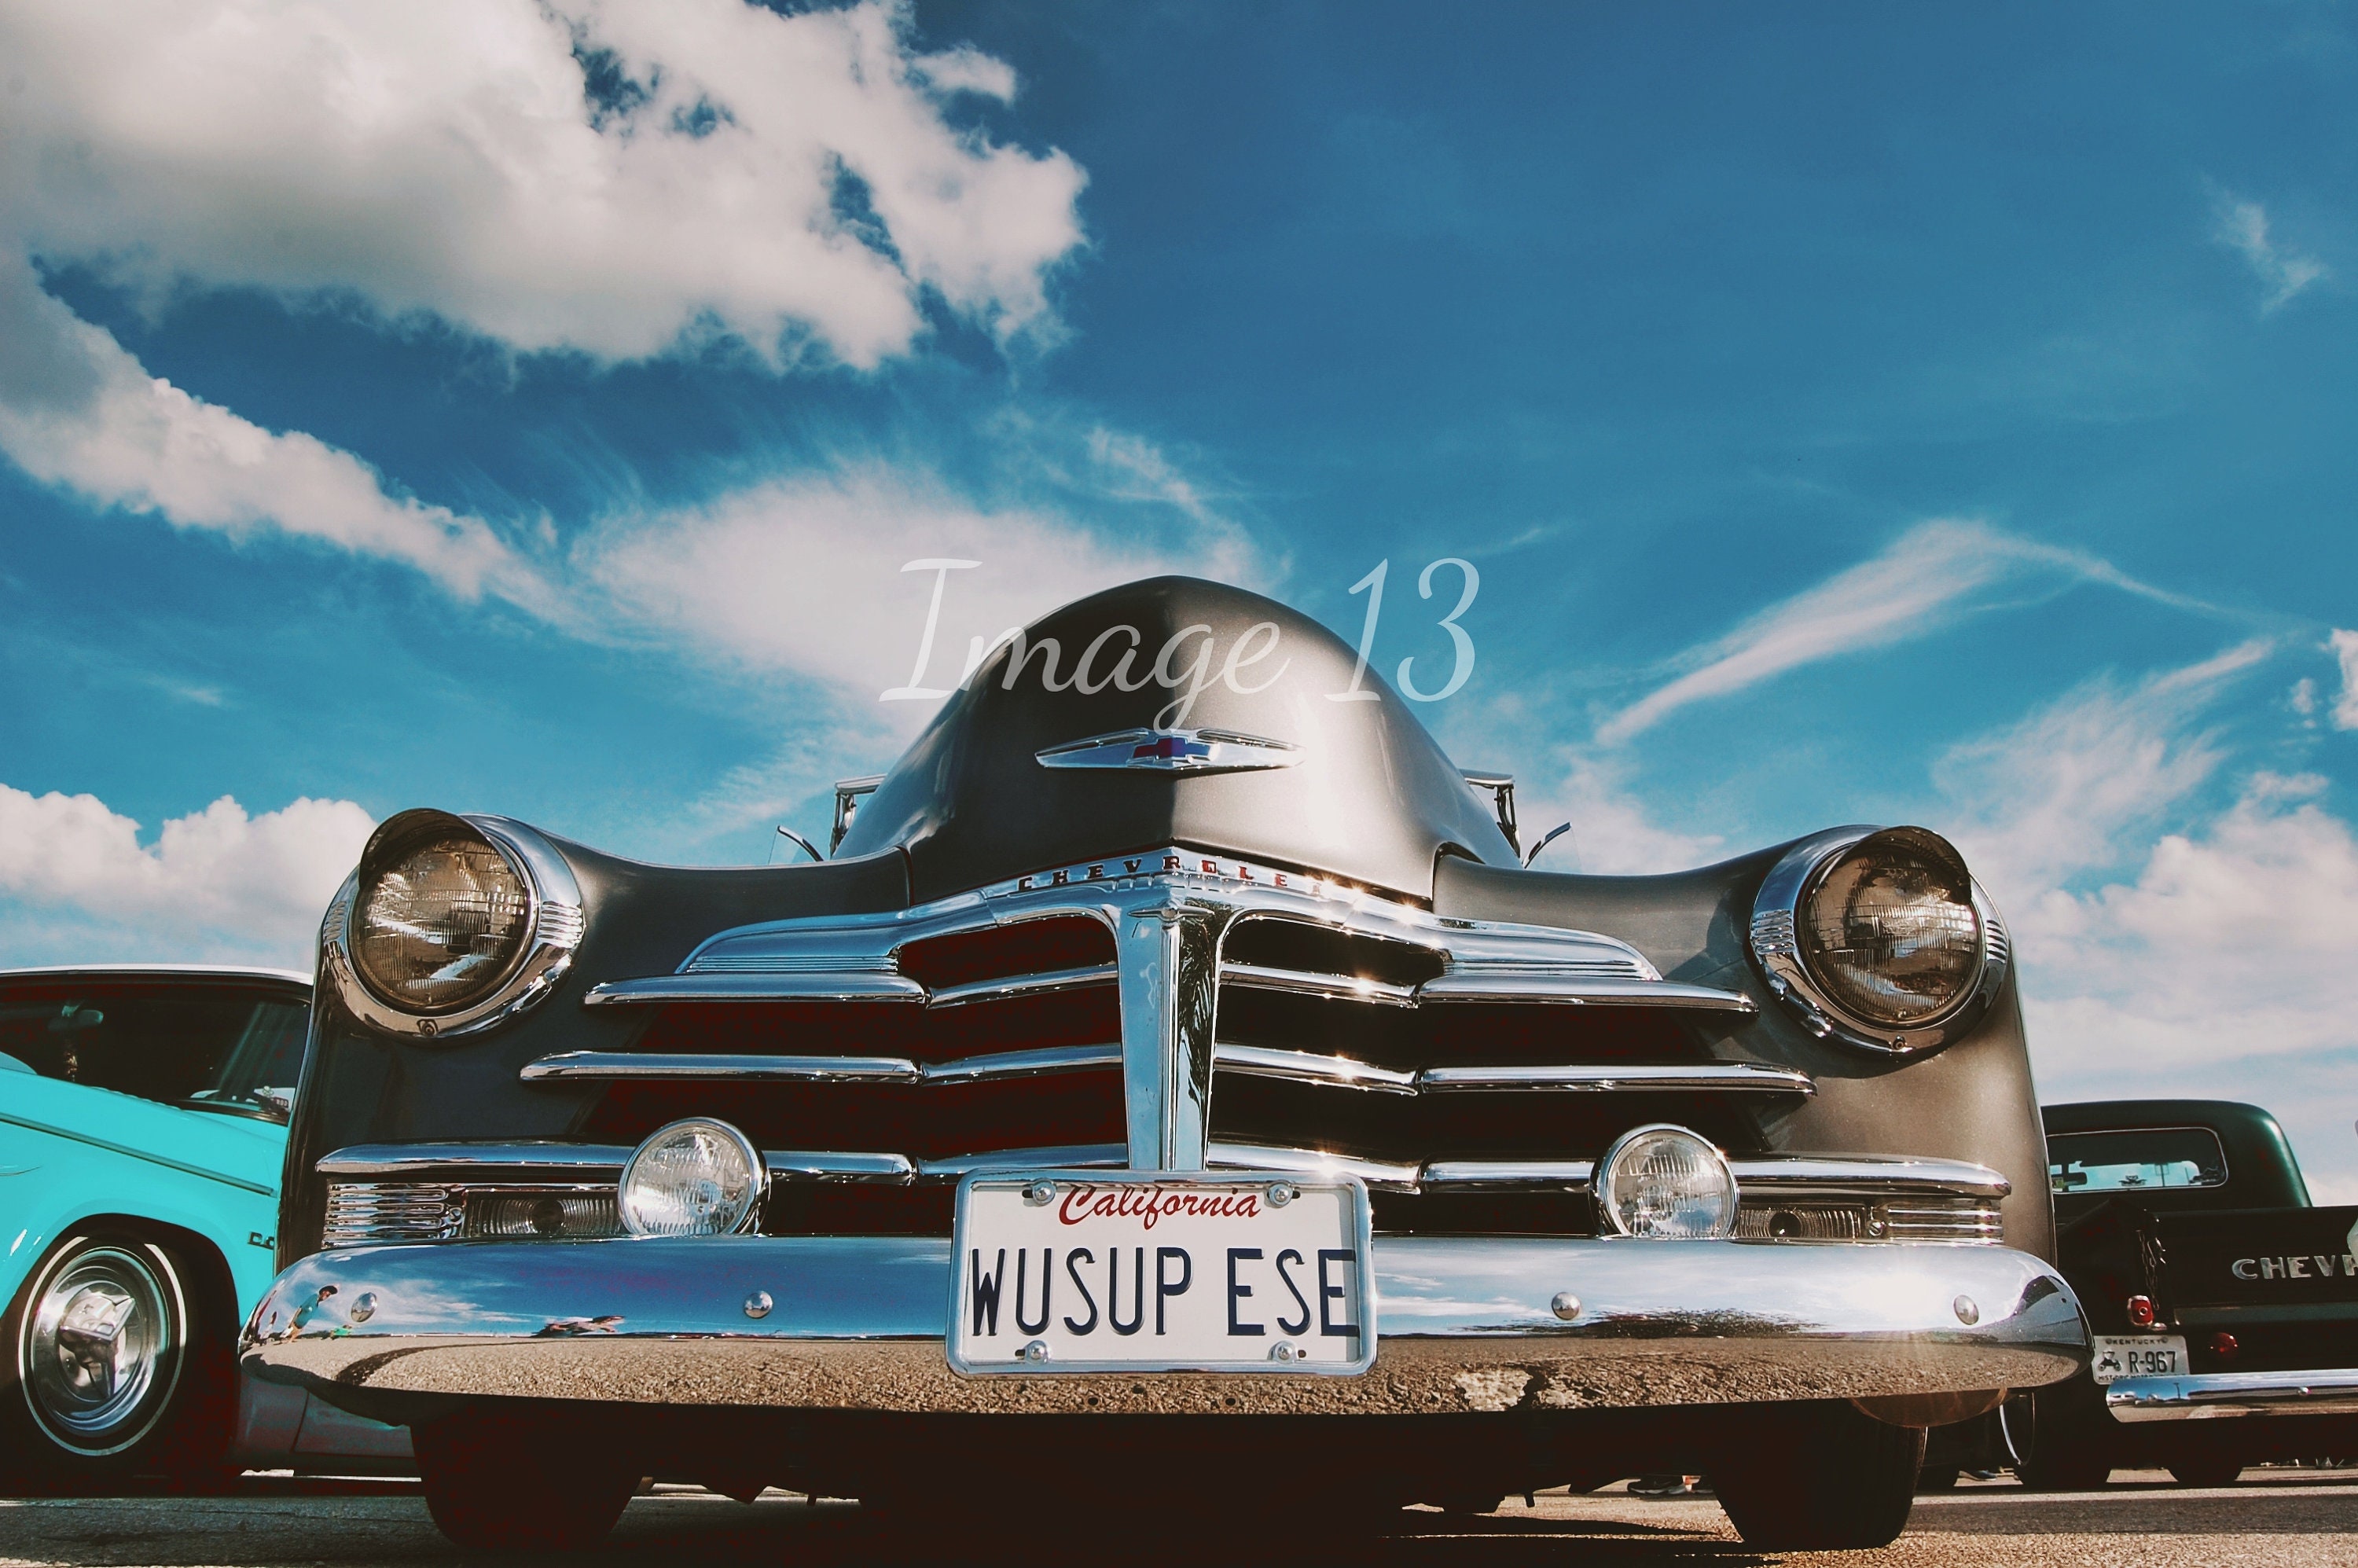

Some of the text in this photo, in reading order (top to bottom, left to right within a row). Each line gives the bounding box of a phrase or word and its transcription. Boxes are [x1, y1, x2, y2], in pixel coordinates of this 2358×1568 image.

[1059, 1184, 1261, 1230] California
[971, 1247, 1361, 1337] WUSUP ESE
[2128, 1351, 2176, 1373] R-967
